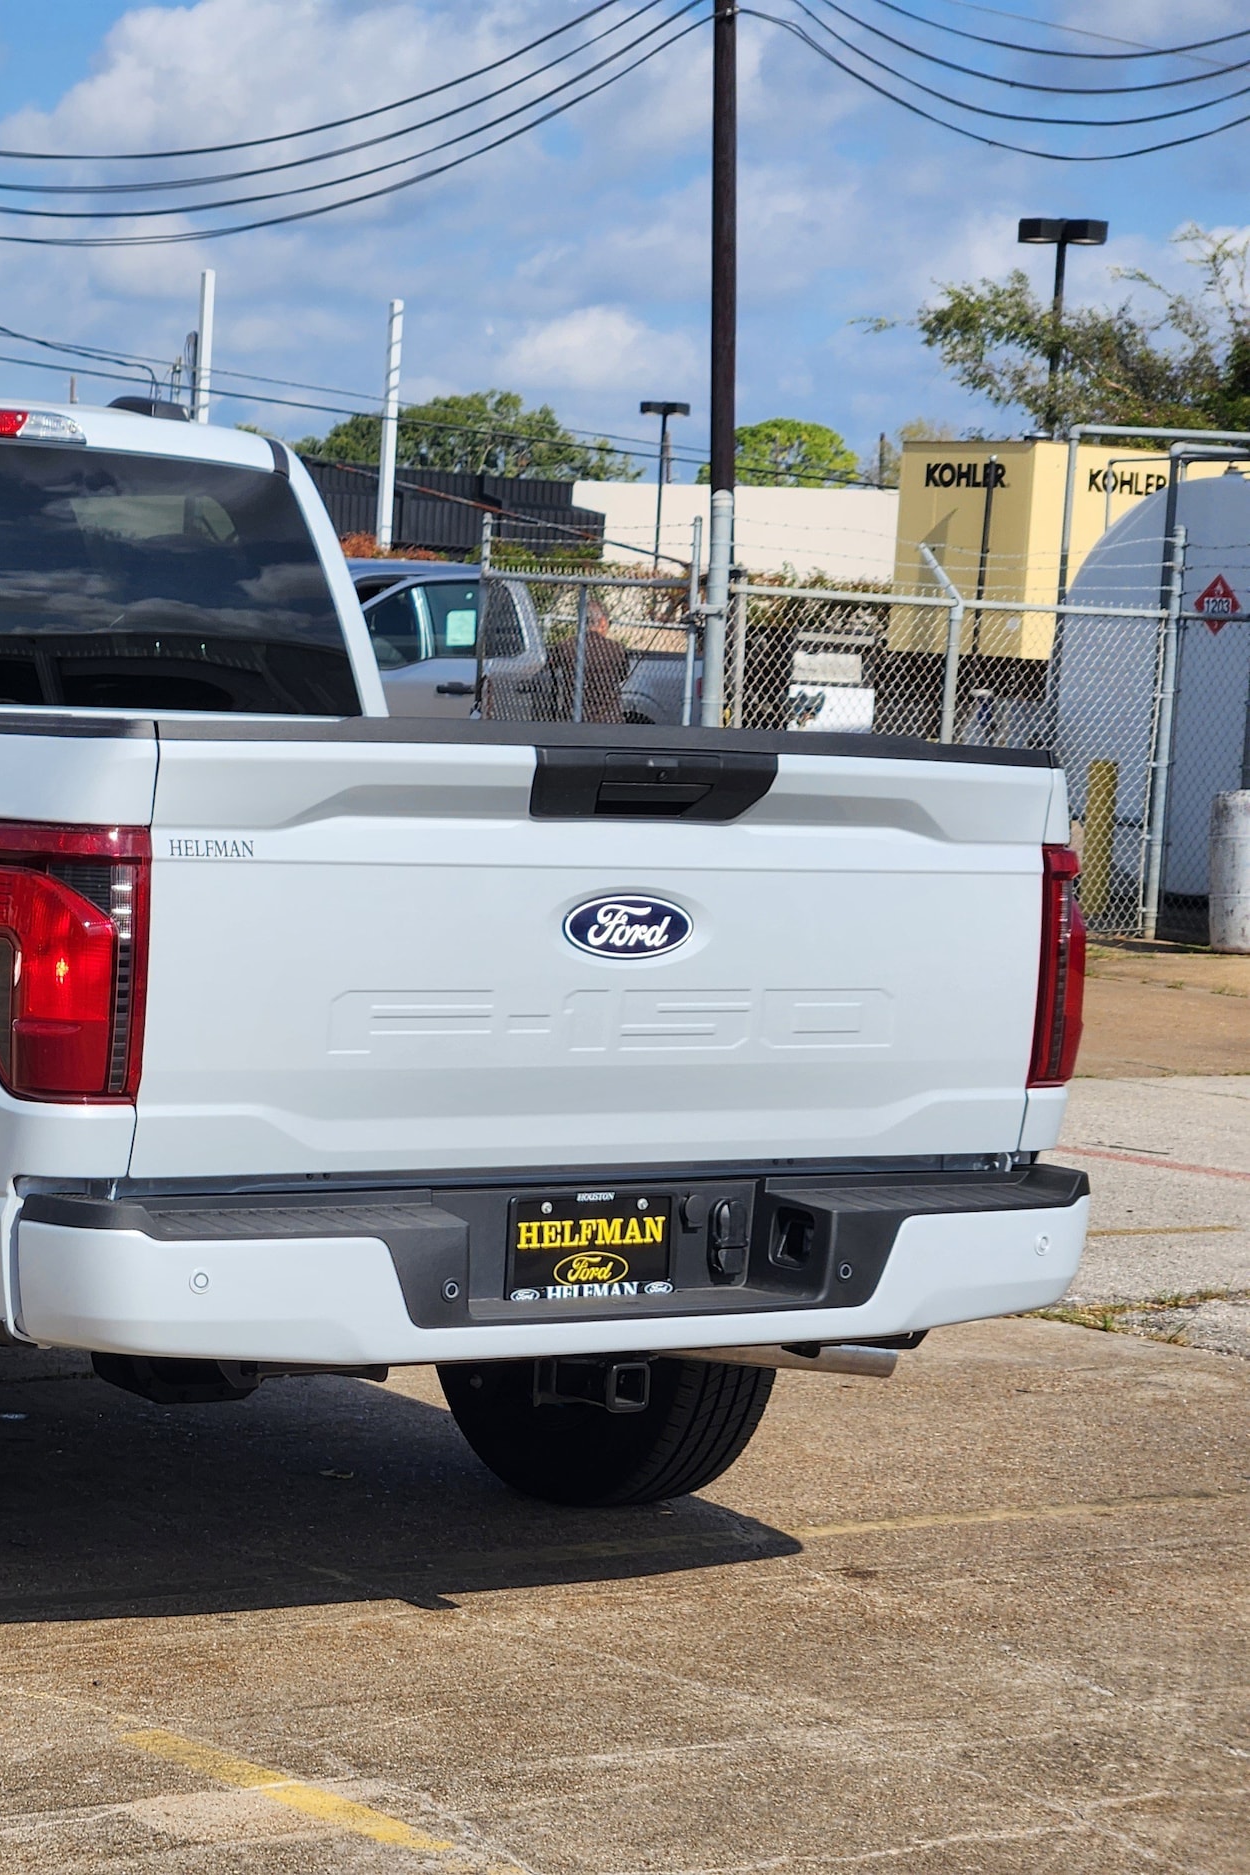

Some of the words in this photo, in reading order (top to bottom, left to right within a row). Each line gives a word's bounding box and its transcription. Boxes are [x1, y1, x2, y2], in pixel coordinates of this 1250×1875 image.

[925, 463, 1007, 488] KOHLER
[1205, 598, 1231, 614] 1203
[169, 839, 255, 858] HELFMAN
[587, 903, 673, 947] Ford
[576, 1192, 616, 1202] HOUSTON
[516, 1215, 667, 1250] HELFMAN
[566, 1256, 614, 1282] Ford
